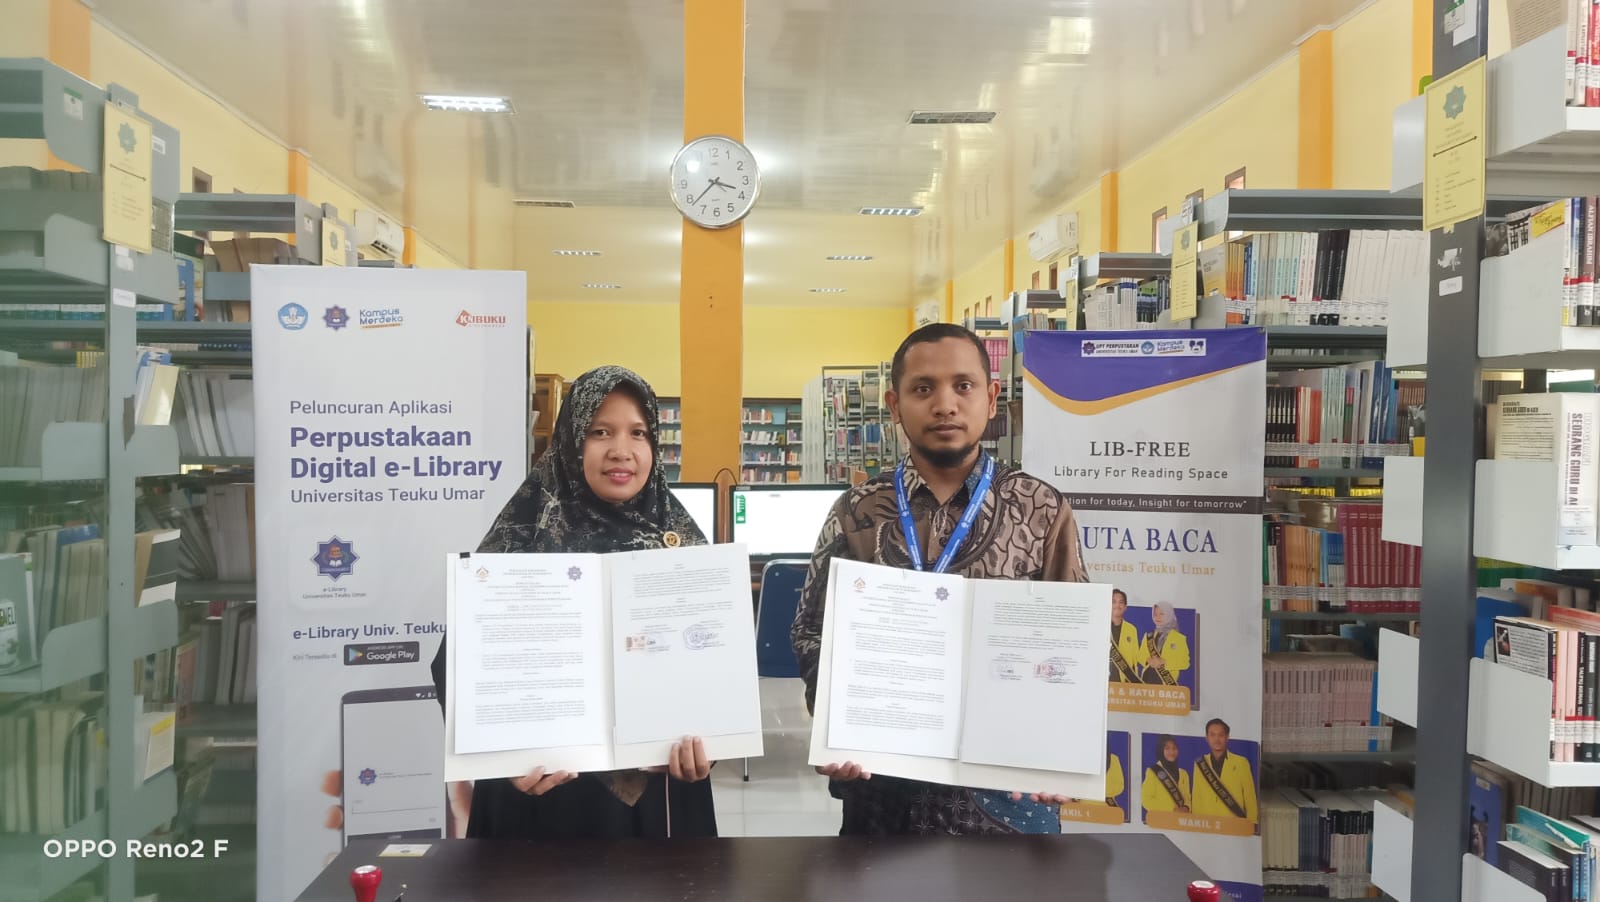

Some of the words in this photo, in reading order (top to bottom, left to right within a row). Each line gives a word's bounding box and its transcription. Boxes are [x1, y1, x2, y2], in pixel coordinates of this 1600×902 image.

[725, 150, 730, 160] 1
[736, 161, 744, 171] 2
[680, 179, 688, 190] 9
[742, 176, 749, 186] 3
[686, 194, 694, 204] 8
[738, 190, 745, 200] 4
[700, 205, 706, 214] 7
[713, 208, 720, 217] 6
[727, 202, 734, 212] 5
[360, 308, 400, 318] Kampus
[360, 316, 403, 325] Merdeka
[290, 400, 384, 414] Peluncuran
[389, 400, 452, 417] Aplikasi
[290, 426, 472, 452] Perpustakaan
[1570, 413, 1583, 457] SEORANG
[1090, 441, 1190, 458] LIB-FREE
[290, 456, 376, 483] Digital
[384, 456, 502, 481] e-Library
[1054, 466, 1100, 480] Library
[1105, 467, 1126, 478] For
[1132, 467, 1183, 480] Reading
[1188, 468, 1228, 481] Space
[1569, 460, 1581, 485] GURU
[290, 488, 384, 503] Universitas
[389, 488, 438, 501] Teuku
[443, 488, 485, 500] Umar
[1090, 496, 1104, 506] for
[1107, 498, 1136, 508] today,
[1138, 498, 1172, 508] Insight
[1176, 499, 1191, 507] for
[1082, 526, 1136, 550] UTA
[1145, 528, 1218, 553] BACA
[1138, 562, 1176, 574] Teuku
[1182, 562, 1216, 576] Umar
[293, 626, 359, 640] e-Library
[364, 624, 399, 637] Univ.
[366, 652, 396, 661] Google
[398, 650, 415, 660] Play
[1129, 688, 1155, 698] RATU
[1158, 690, 1186, 699] BACA
[1178, 818, 1211, 828] WAKIL
[1215, 820, 1221, 830] 2
